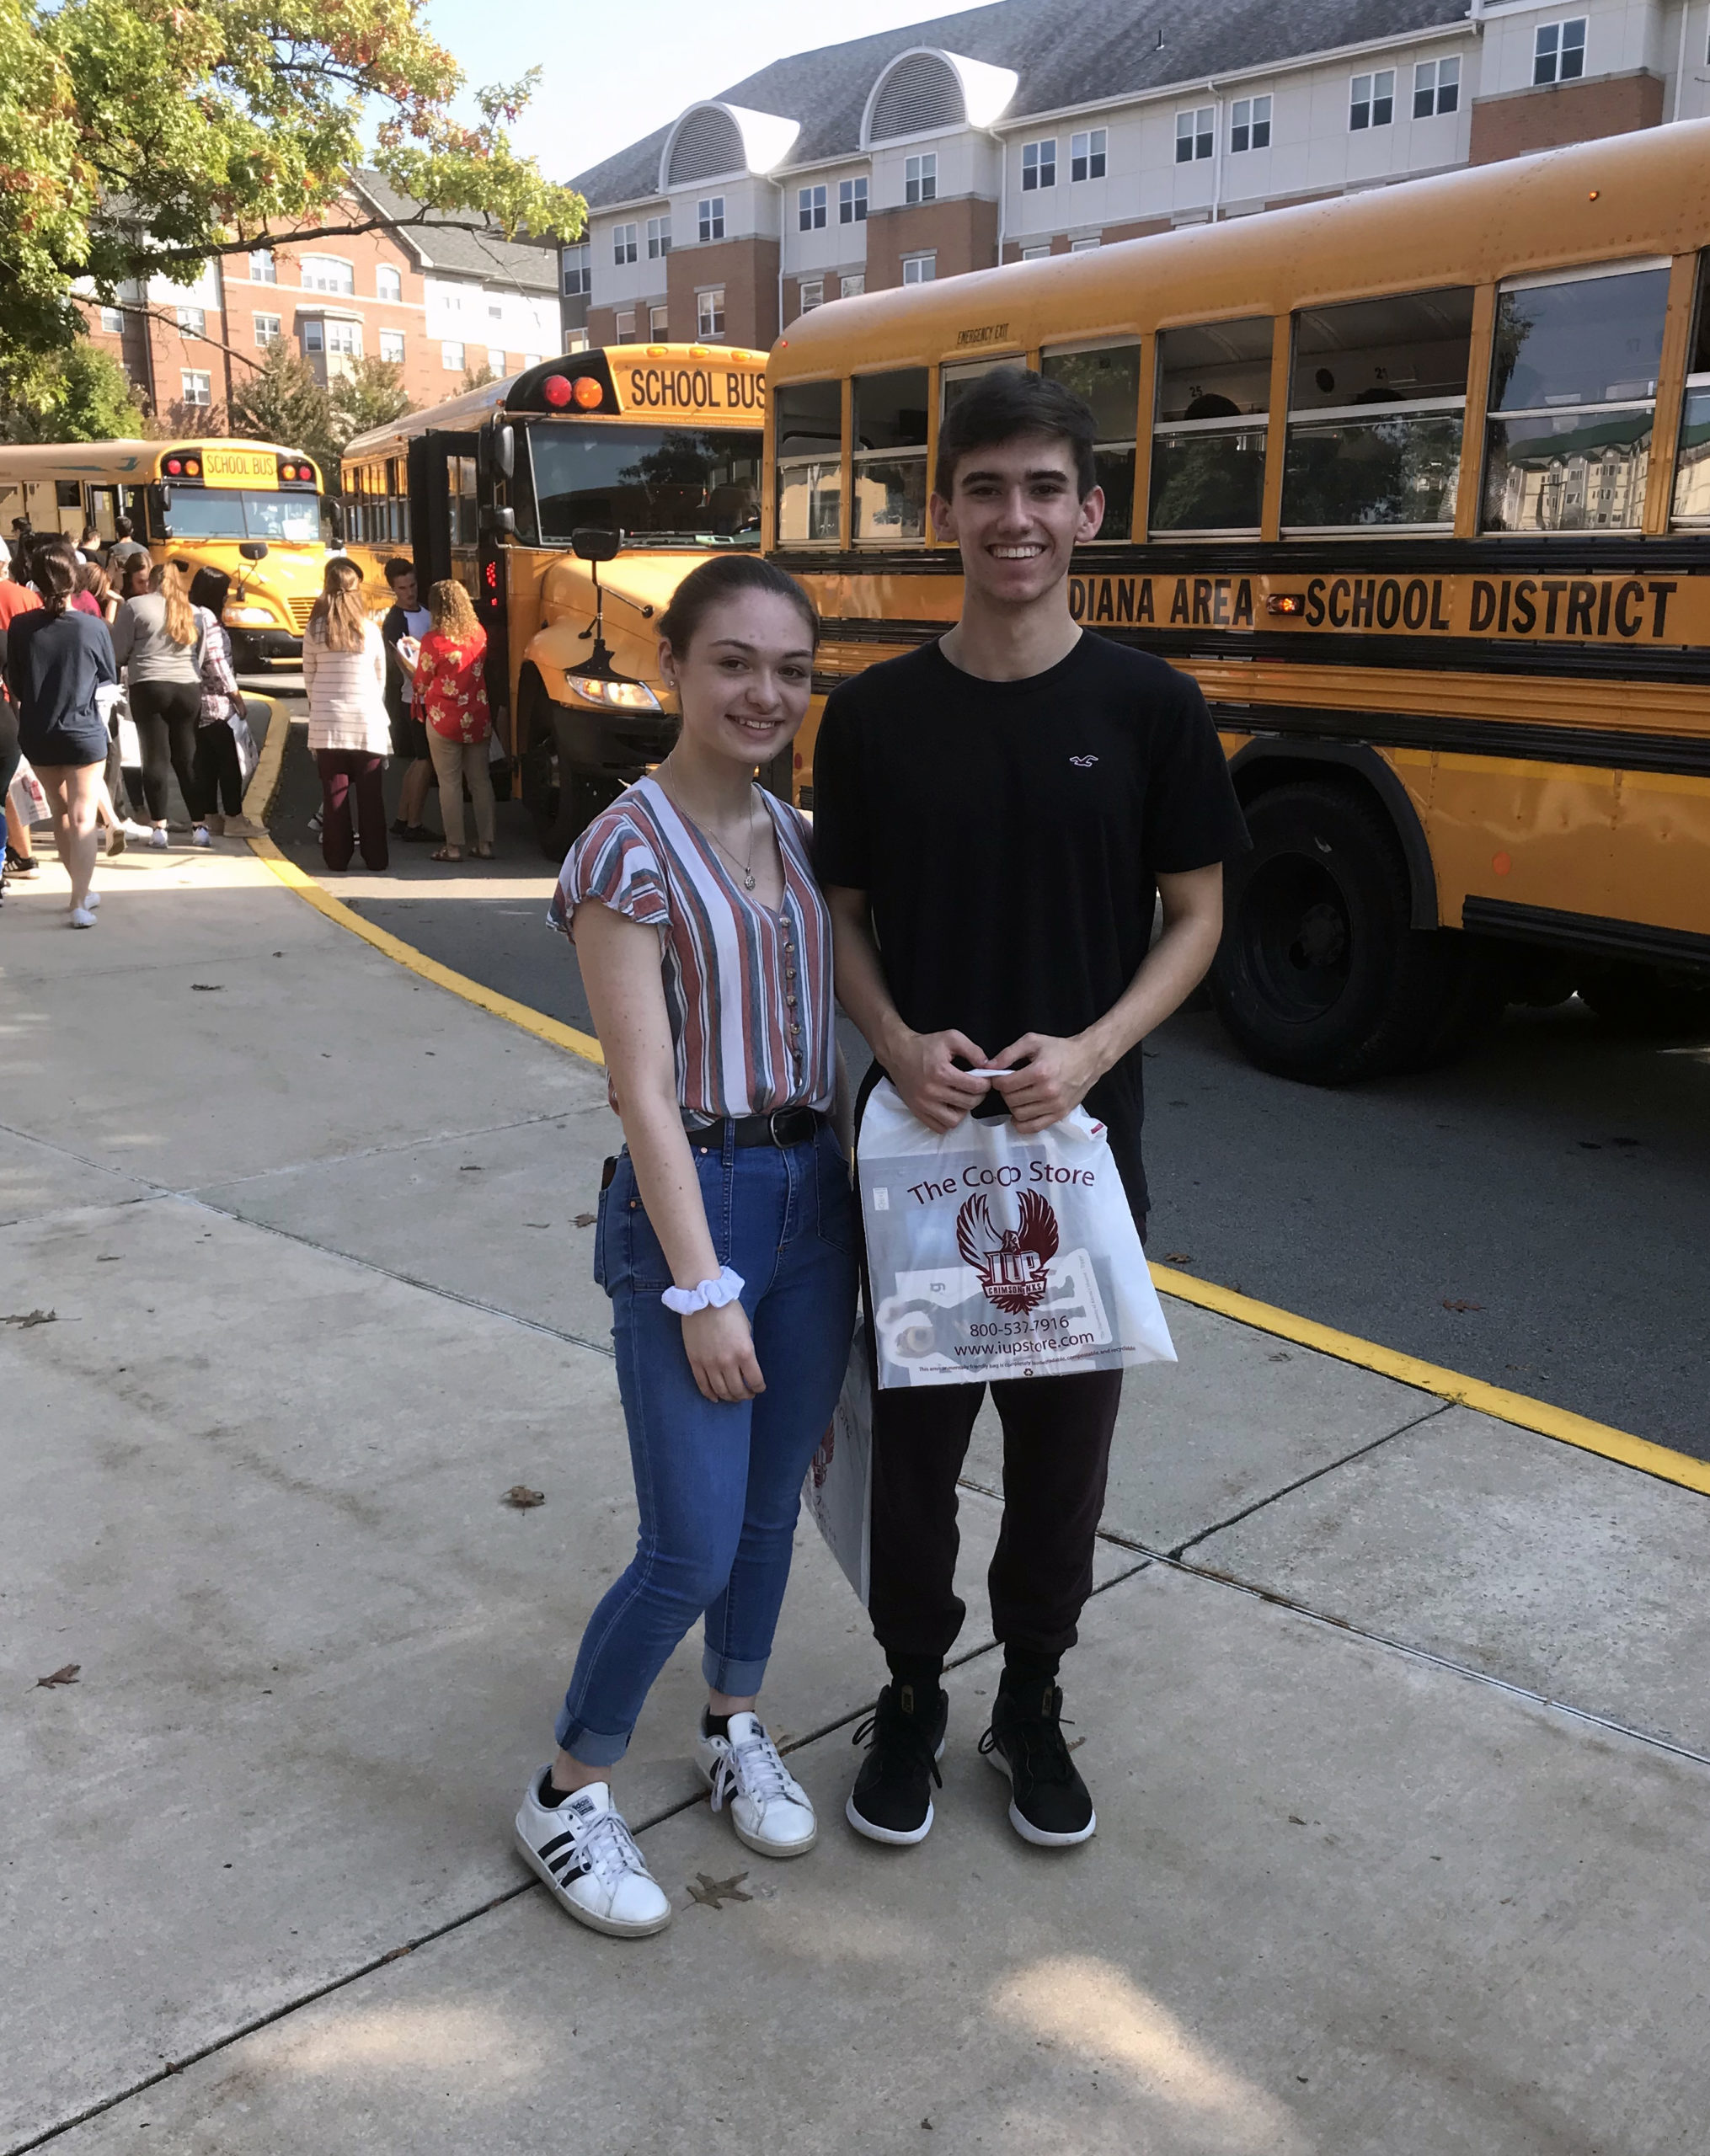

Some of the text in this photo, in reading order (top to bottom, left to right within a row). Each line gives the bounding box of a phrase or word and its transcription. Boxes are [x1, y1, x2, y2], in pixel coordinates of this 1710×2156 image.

[957, 323, 1009, 344] EMERGENCY EXIT
[631, 369, 766, 409] SCHOOL BUS
[206, 455, 275, 476] SCHOOL BUS
[1069, 578, 1678, 638] DIANA AREA SCHOOL DISTRICT
[906, 1177, 958, 1205] The
[1029, 1161, 1095, 1187] Store
[987, 1250, 1042, 1285] IUP
[988, 1284, 1023, 1295] CRIMSON
[970, 1315, 1070, 1337] 800-537-7916
[954, 1331, 1095, 1357] www.iupstore.com
